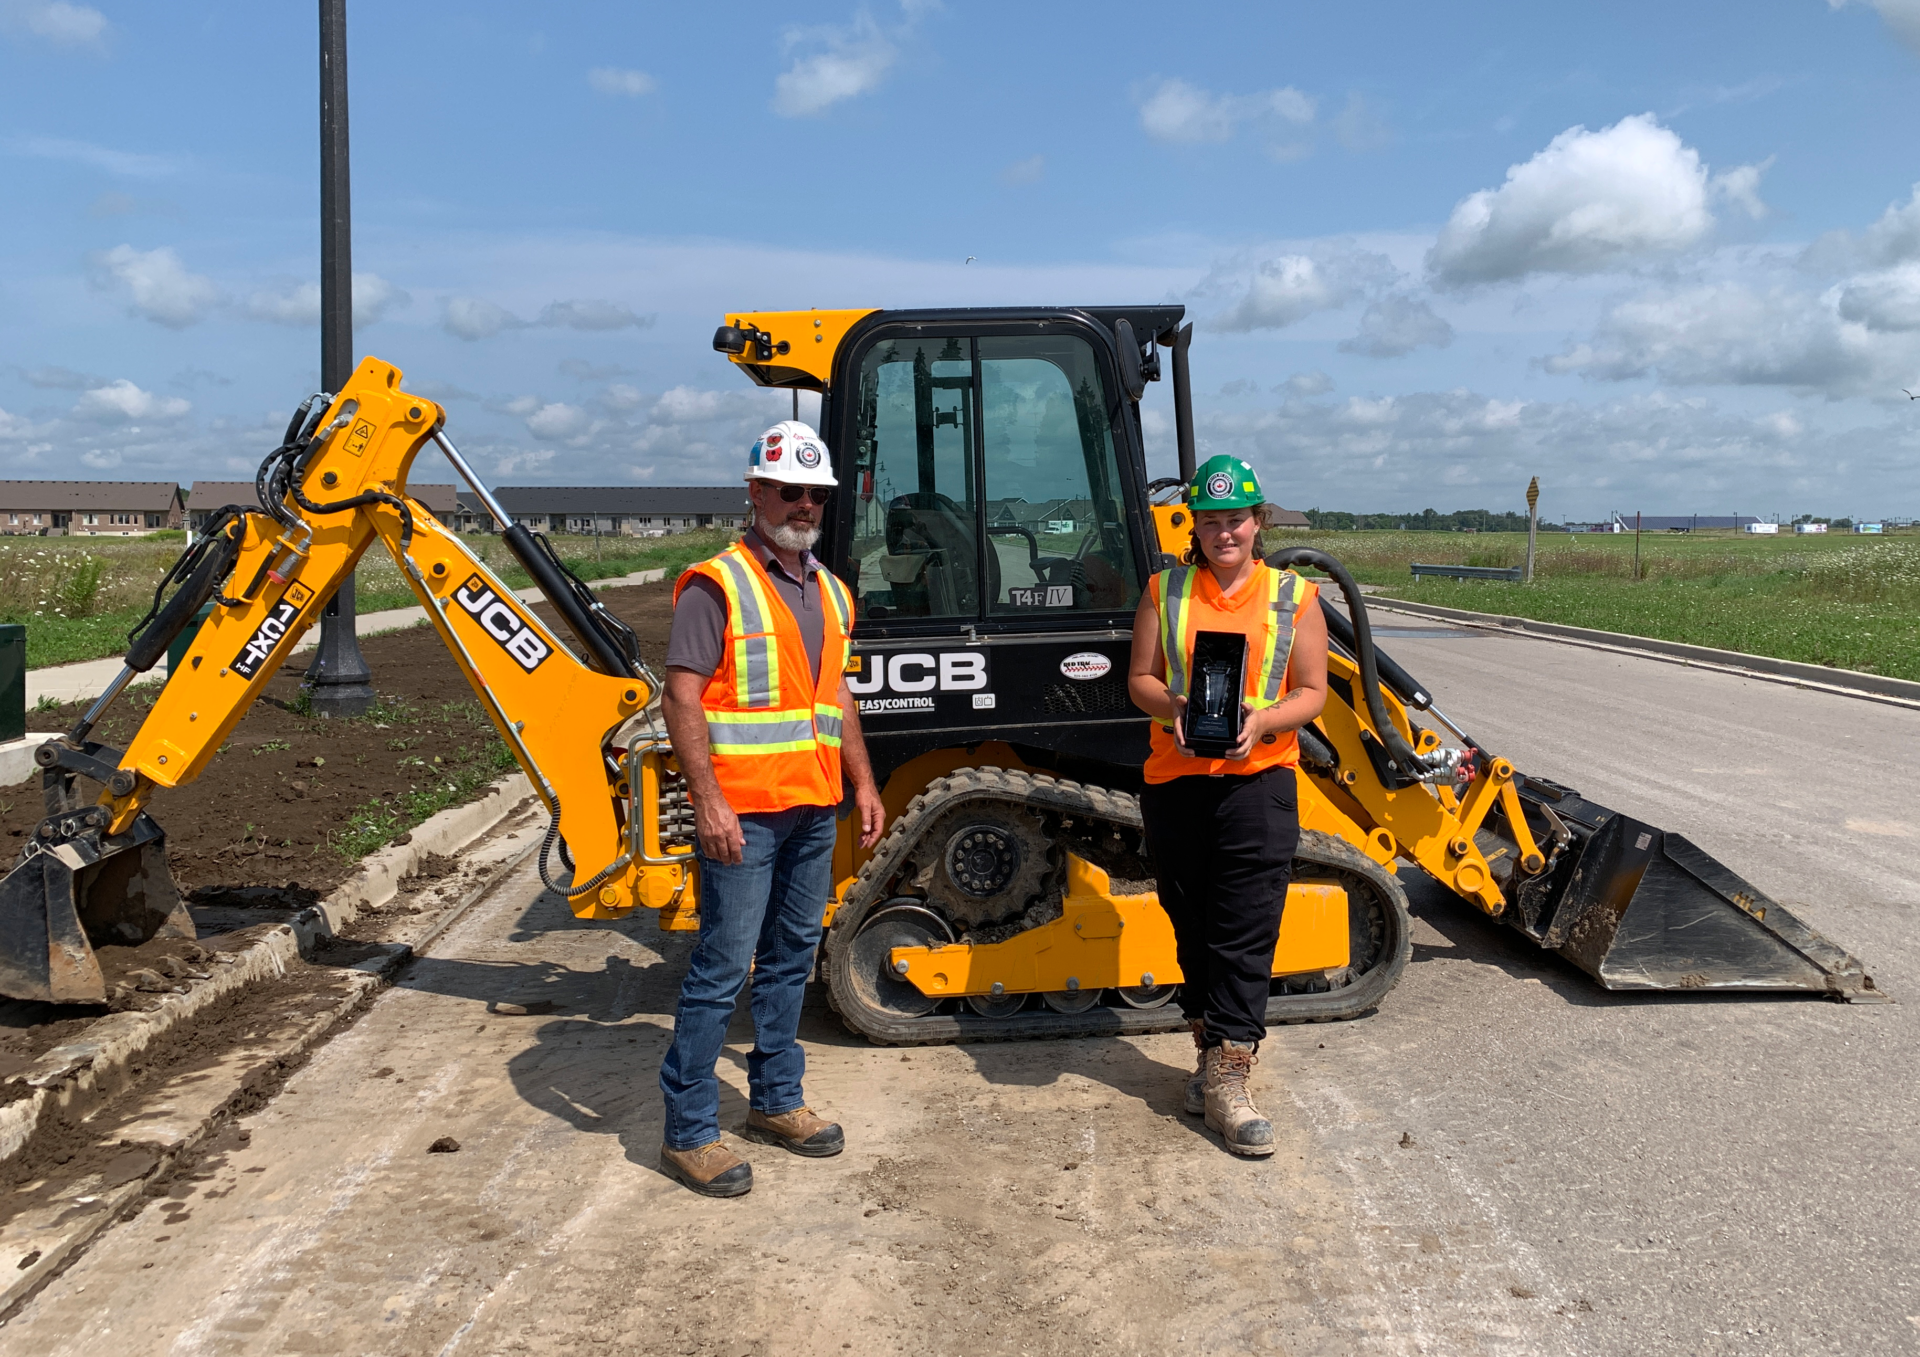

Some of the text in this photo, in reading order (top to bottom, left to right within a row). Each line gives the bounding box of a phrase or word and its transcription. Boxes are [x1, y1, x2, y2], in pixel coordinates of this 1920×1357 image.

[1012, 589, 1044, 606] T4F
[245, 604, 295, 665] 1CXT
[457, 587, 547, 669] JCB
[235, 662, 251, 674] HF
[846, 652, 987, 693] JCB
[859, 697, 935, 712] EASYCONTROL
